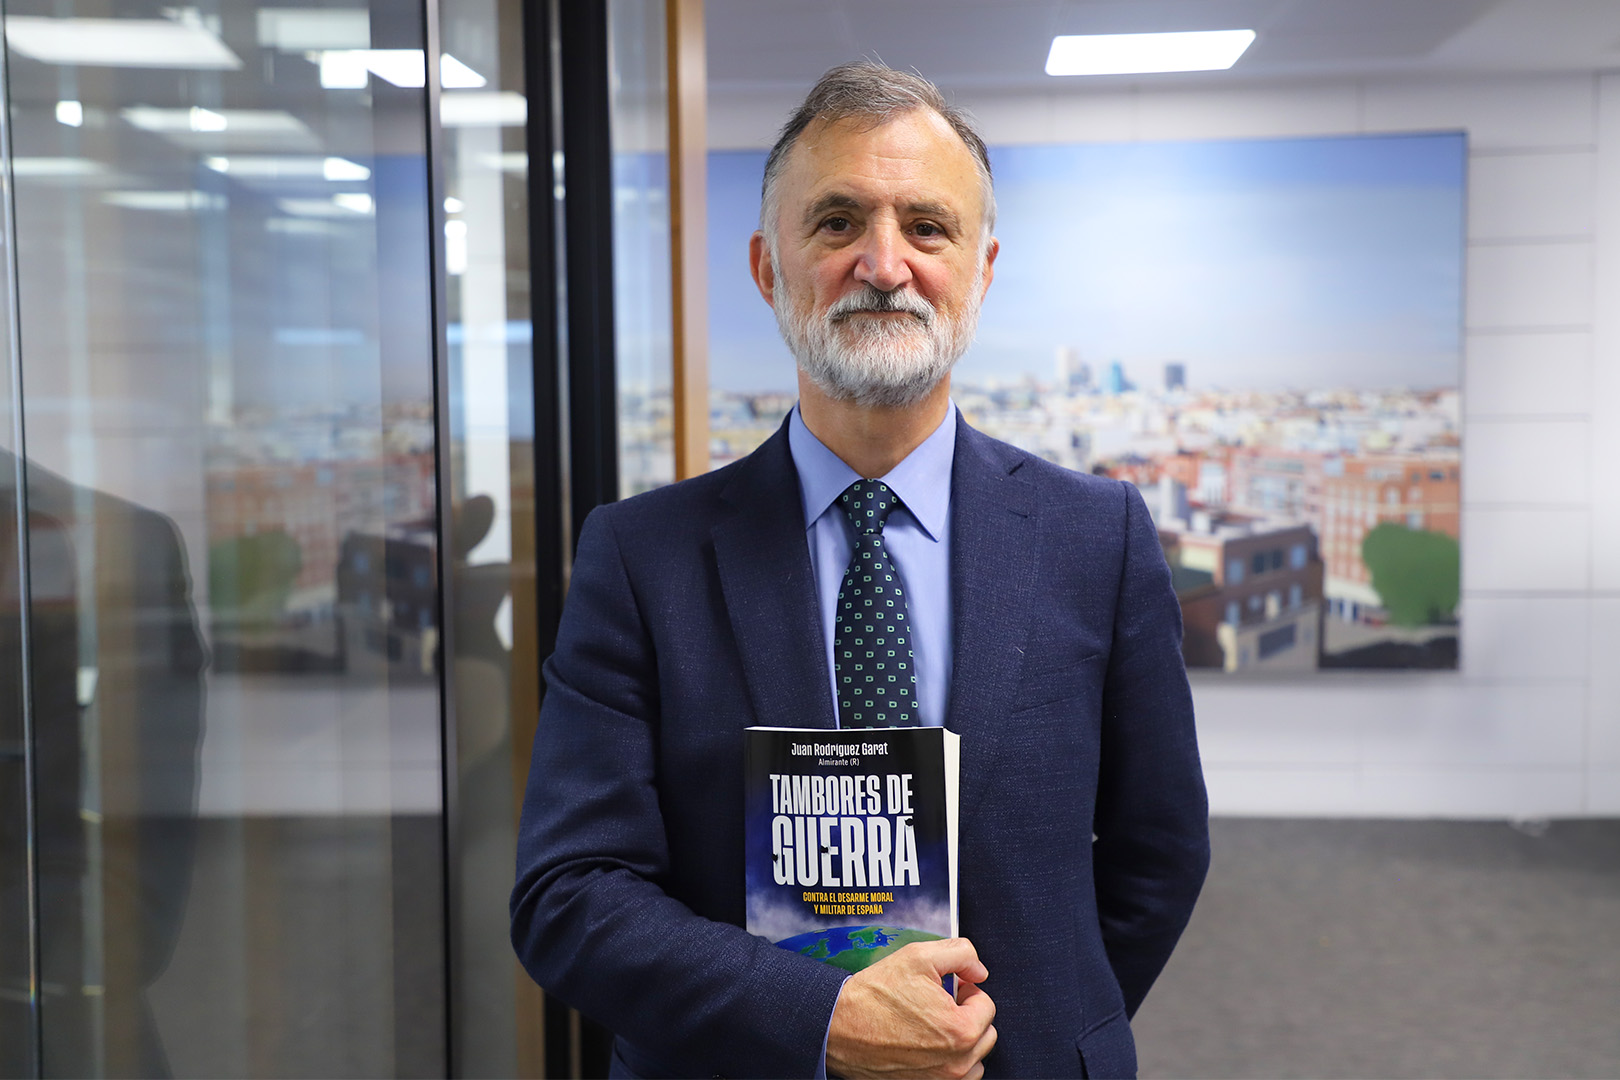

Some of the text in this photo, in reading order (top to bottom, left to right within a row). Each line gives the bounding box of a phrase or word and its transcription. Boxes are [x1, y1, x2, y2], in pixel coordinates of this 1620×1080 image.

[791, 742, 813, 756] Juan
[861, 742, 889, 756] Garat
[818, 758, 860, 767] Almirante (R)
[769, 774, 914, 815] TAMBORES DE
[772, 815, 920, 887] GUERRA
[802, 892, 894, 903] CONTRA EL DESARME MORAL
[813, 903, 884, 914] Y MILITAR DE ESPAÑA
